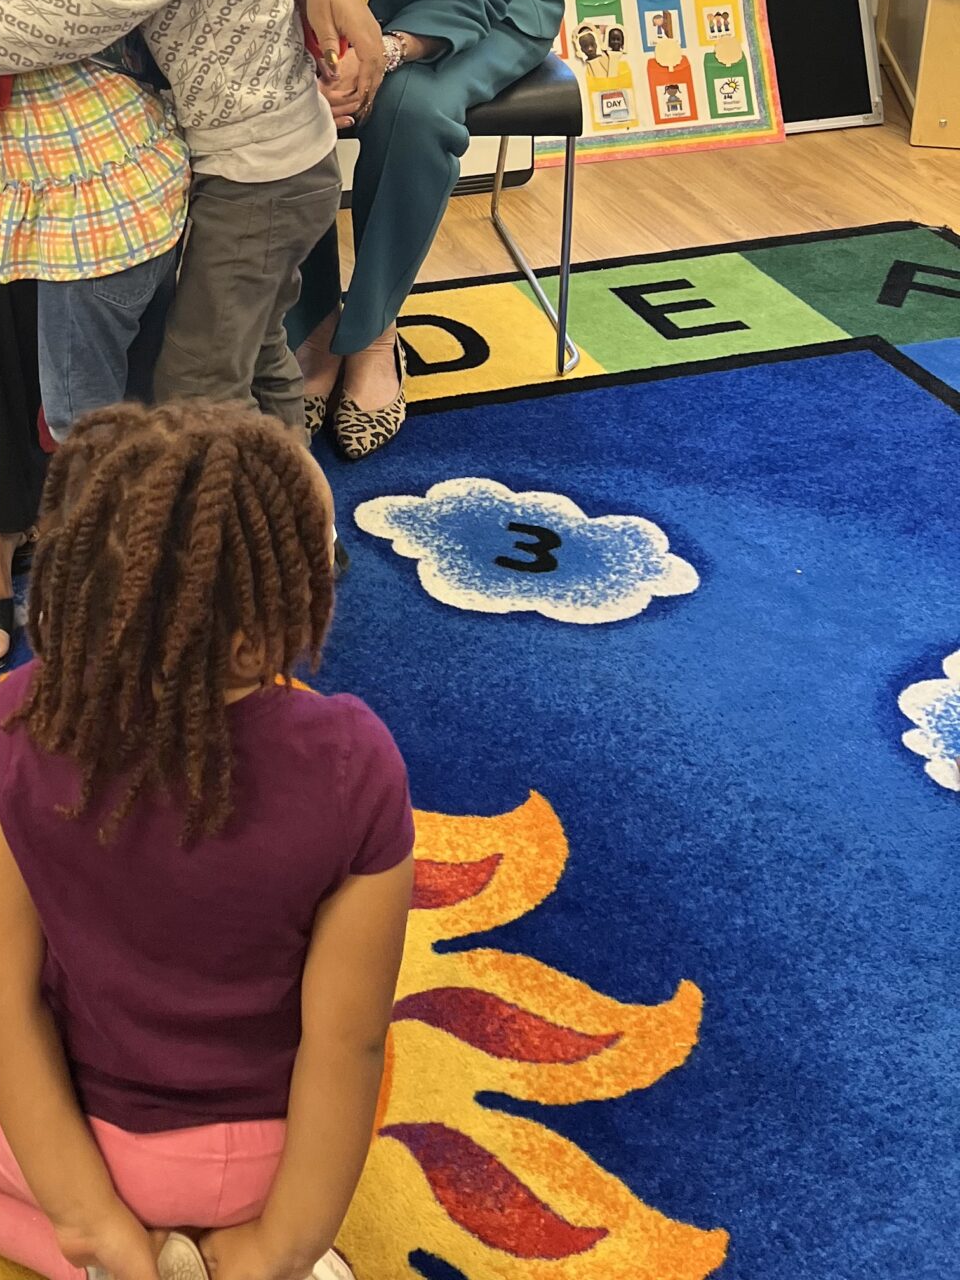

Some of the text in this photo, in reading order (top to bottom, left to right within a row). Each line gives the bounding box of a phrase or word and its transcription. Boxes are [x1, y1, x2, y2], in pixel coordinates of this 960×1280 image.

[64, 20, 135, 36] Reebok
[182, 50, 219, 110] Reebok
[247, 32, 281, 95] Reebok
[606, 100, 622, 109] DAY
[397, 314, 490, 376] D
[608, 277, 751, 340] E
[494, 521, 562, 574] 3
